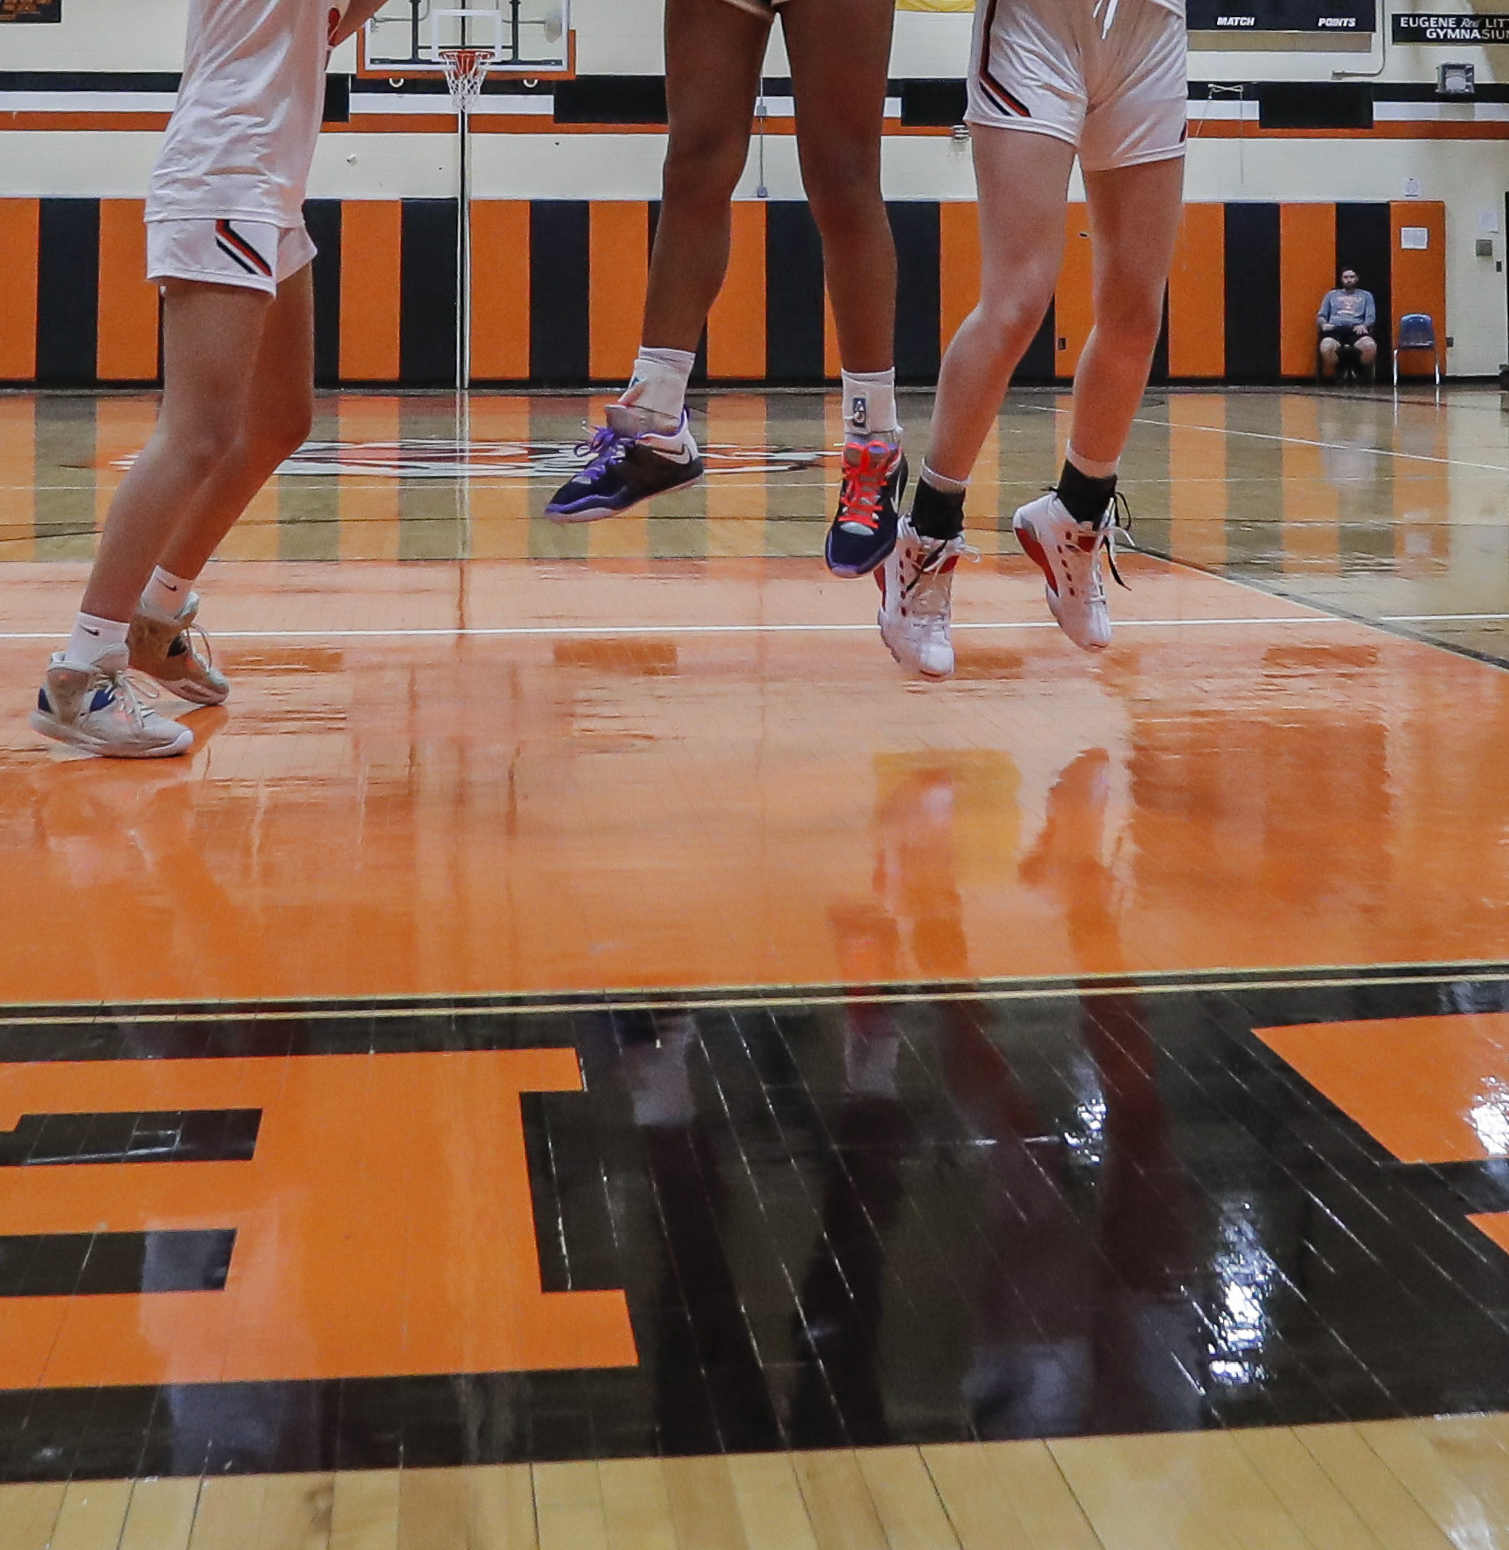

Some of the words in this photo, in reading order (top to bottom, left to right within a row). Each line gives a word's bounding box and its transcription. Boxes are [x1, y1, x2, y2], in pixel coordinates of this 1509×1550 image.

[1217, 16, 1255, 27] MATCH
[1318, 17, 1356, 28] POINTS
[1400, 17, 1457, 28] EUGENE
